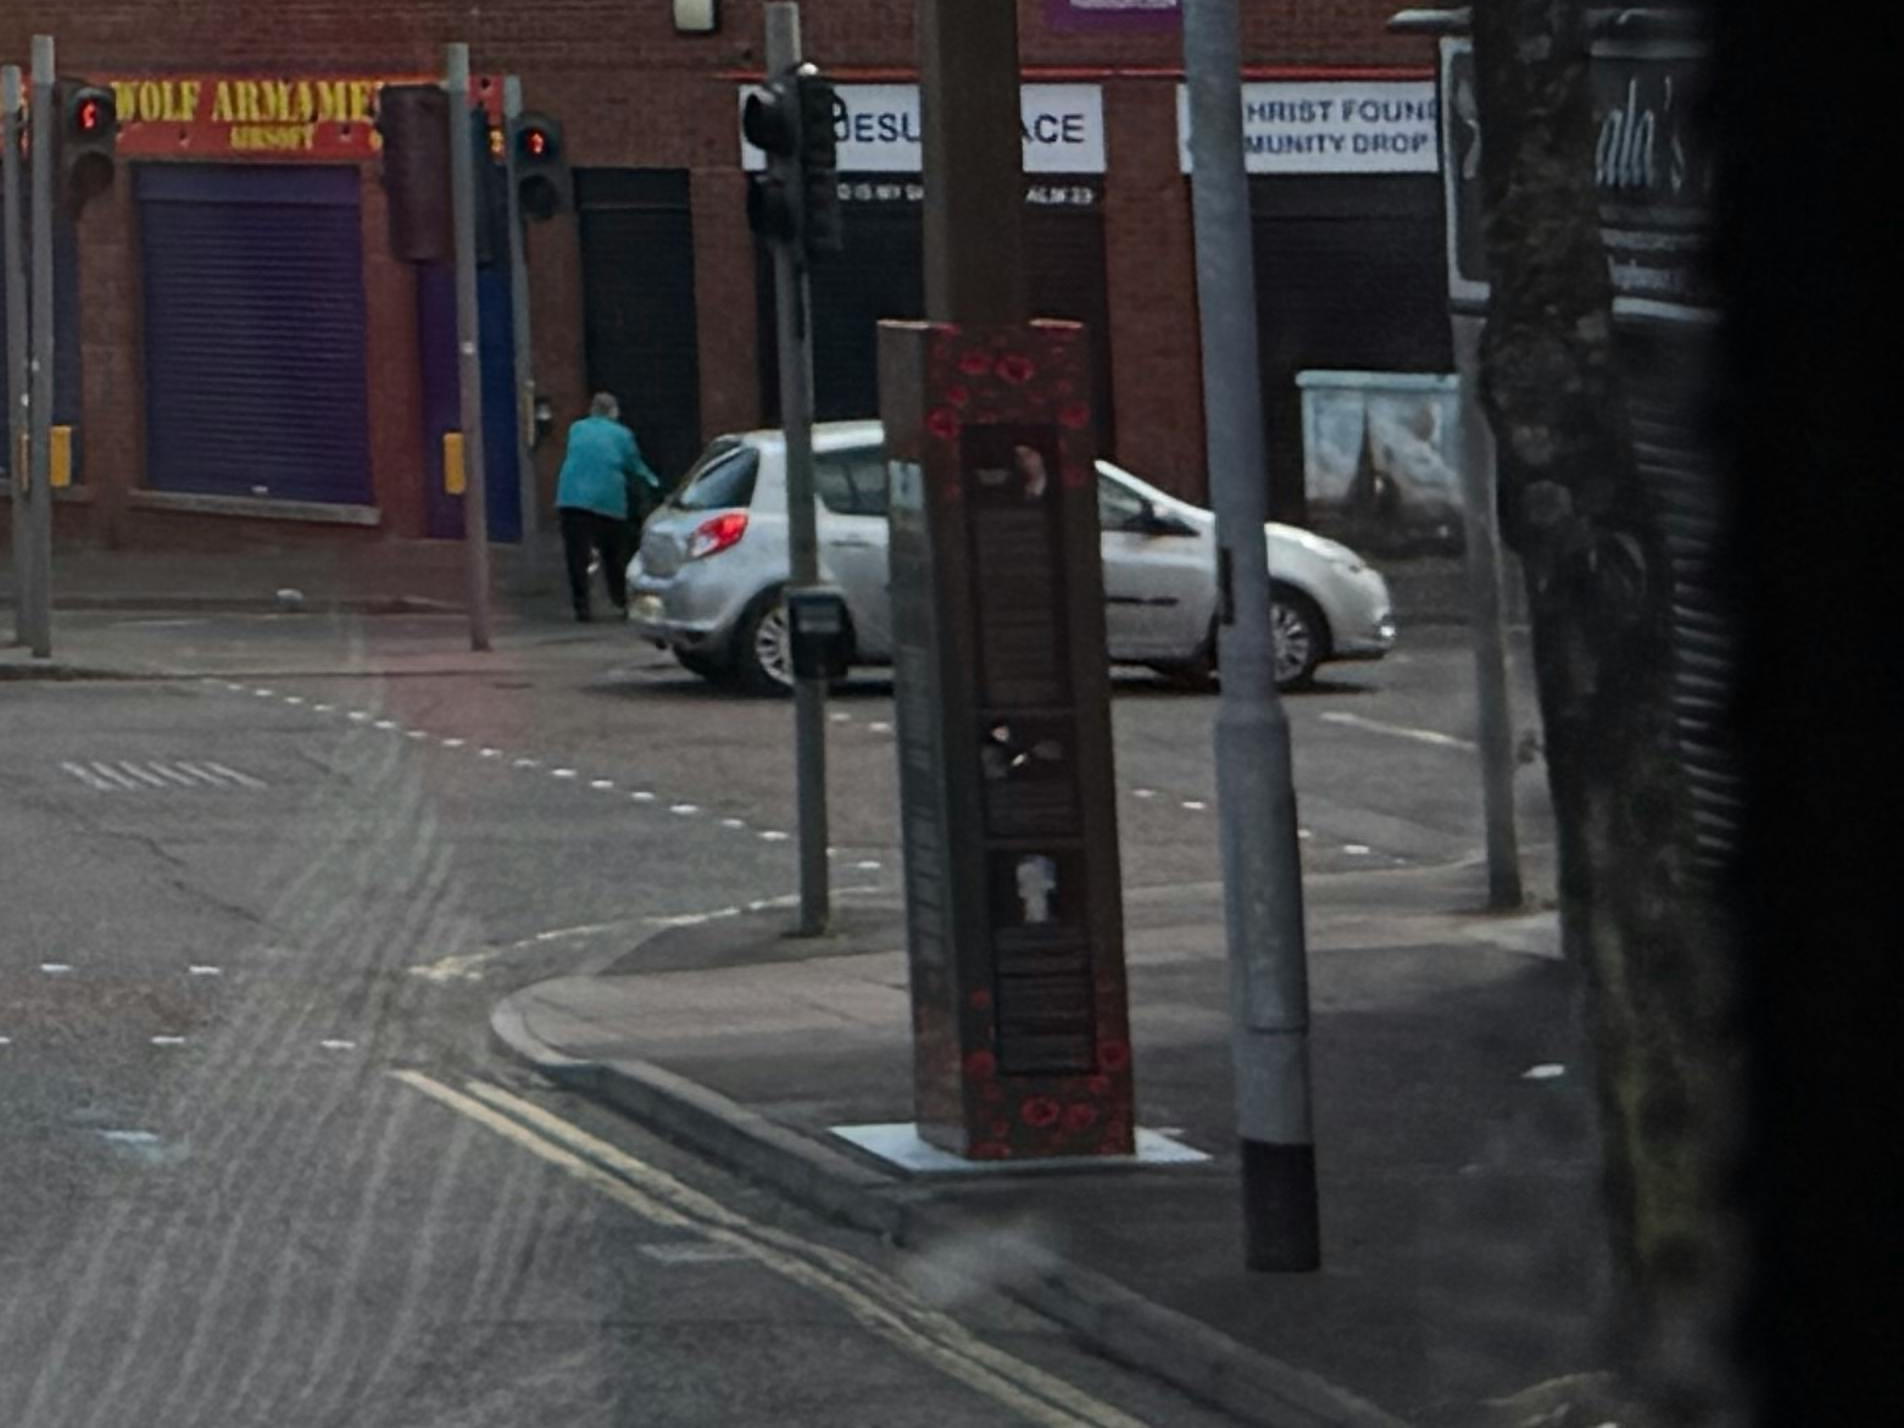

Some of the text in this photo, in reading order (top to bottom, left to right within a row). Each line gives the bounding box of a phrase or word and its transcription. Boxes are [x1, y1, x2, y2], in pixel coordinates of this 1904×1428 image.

[111, 80, 372, 122] WOLF ARMAME
[1247, 98, 1334, 123] HRIST
[833, 112, 922, 143] JESU
[1245, 132, 1429, 155] MUNITY DROP
